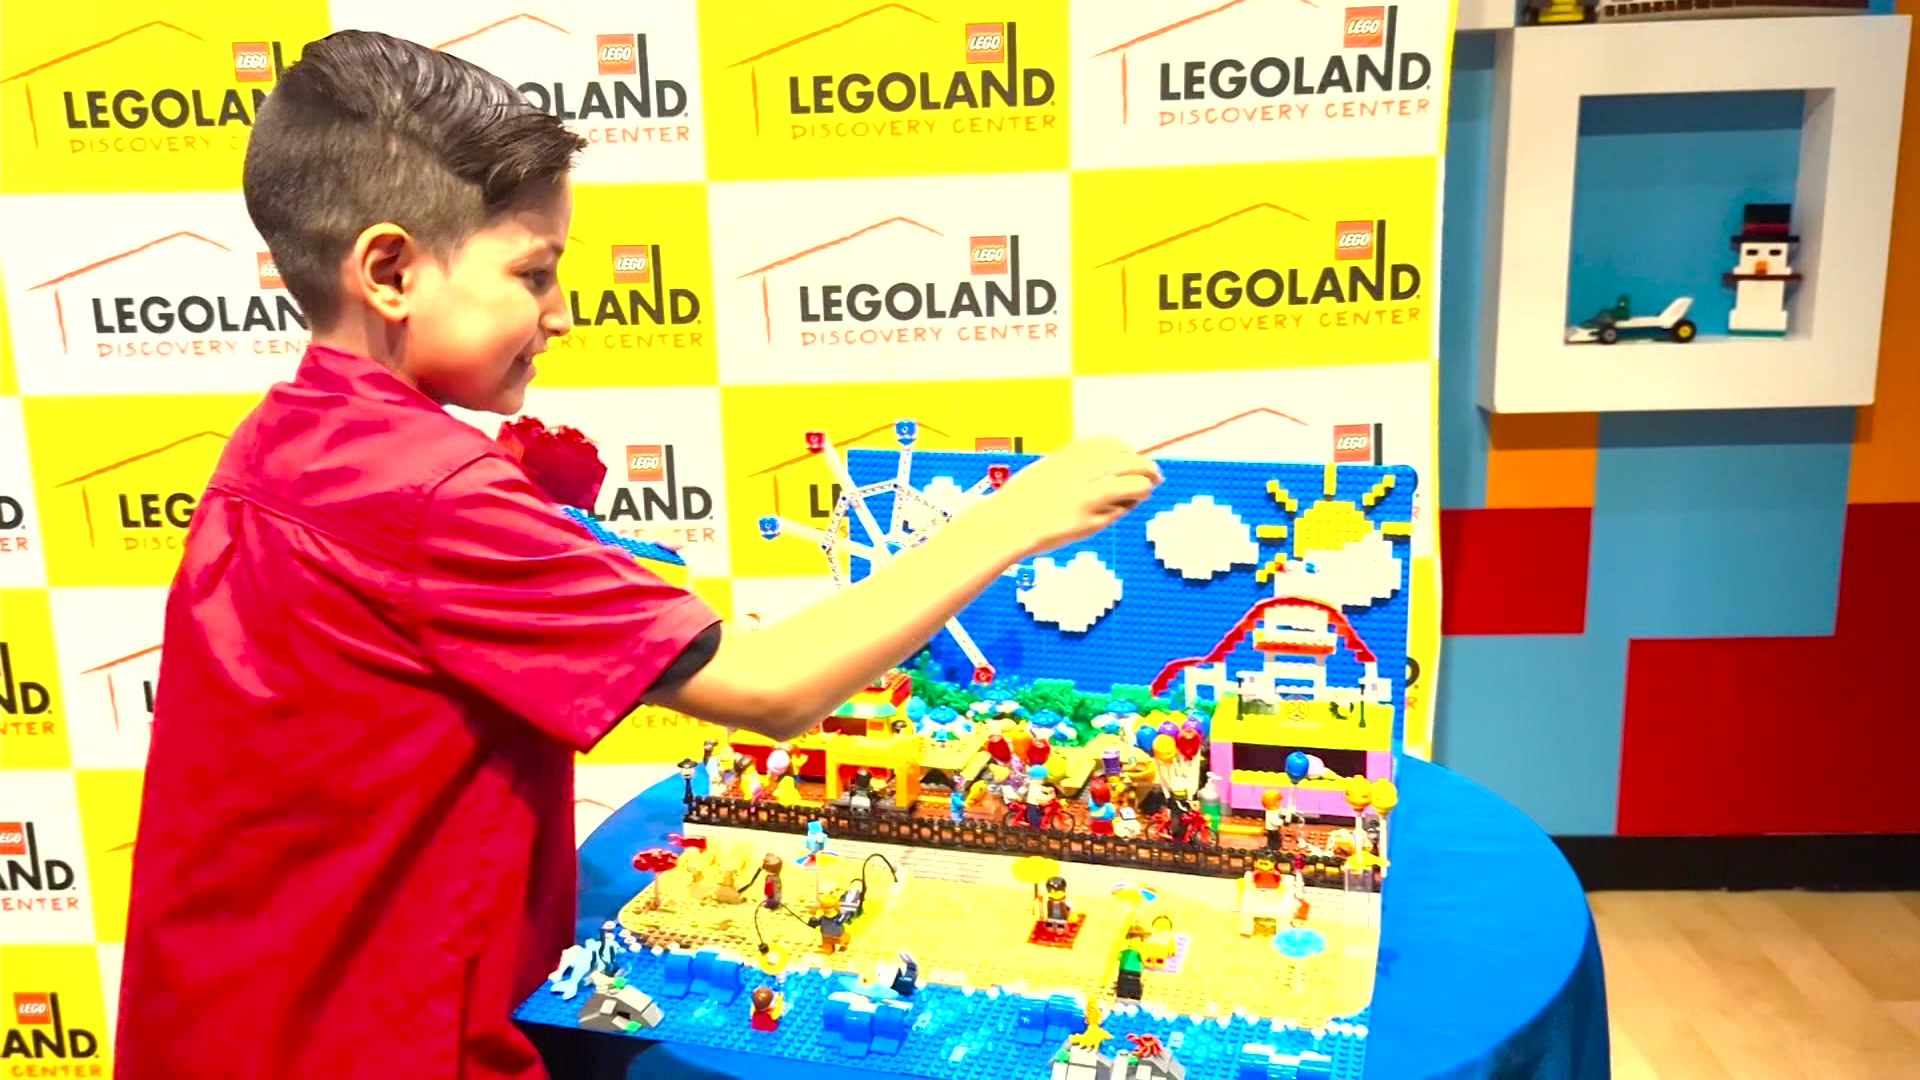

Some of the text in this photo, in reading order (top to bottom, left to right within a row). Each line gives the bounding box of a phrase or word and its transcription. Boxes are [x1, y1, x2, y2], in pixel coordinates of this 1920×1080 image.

[1347, 19, 1380, 35] LEGO
[968, 34, 1001, 50] LEGO
[238, 54, 268, 69] LEGO
[601, 46, 632, 61] LEGO
[1159, 99, 1431, 126] DISCOVERY CENTER
[589, 126, 690, 143] CENTER
[791, 114, 1056, 140] DISCOVERY CENTER
[69, 136, 212, 153] DISCOVERY
[1338, 233, 1370, 248] LEGO
[973, 247, 1004, 263] LEGO
[616, 257, 646, 271] LEGO
[570, 245, 700, 326] LAND
[92, 296, 309, 334] LEGOLAN
[1158, 307, 1420, 334] DISCOVERY CENTER
[604, 333, 703, 349] CENTER
[801, 323, 1058, 346] DISCOVERY CENTER
[97, 340, 237, 357] DISCOVERY
[1336, 437, 1367, 450] LEGO
[631, 456, 660, 470] LEGO
[2, 897, 79, 911] ENTER
[18, 1003, 47, 1014] LEGO
[11, 1064, 102, 1078] CENTER
